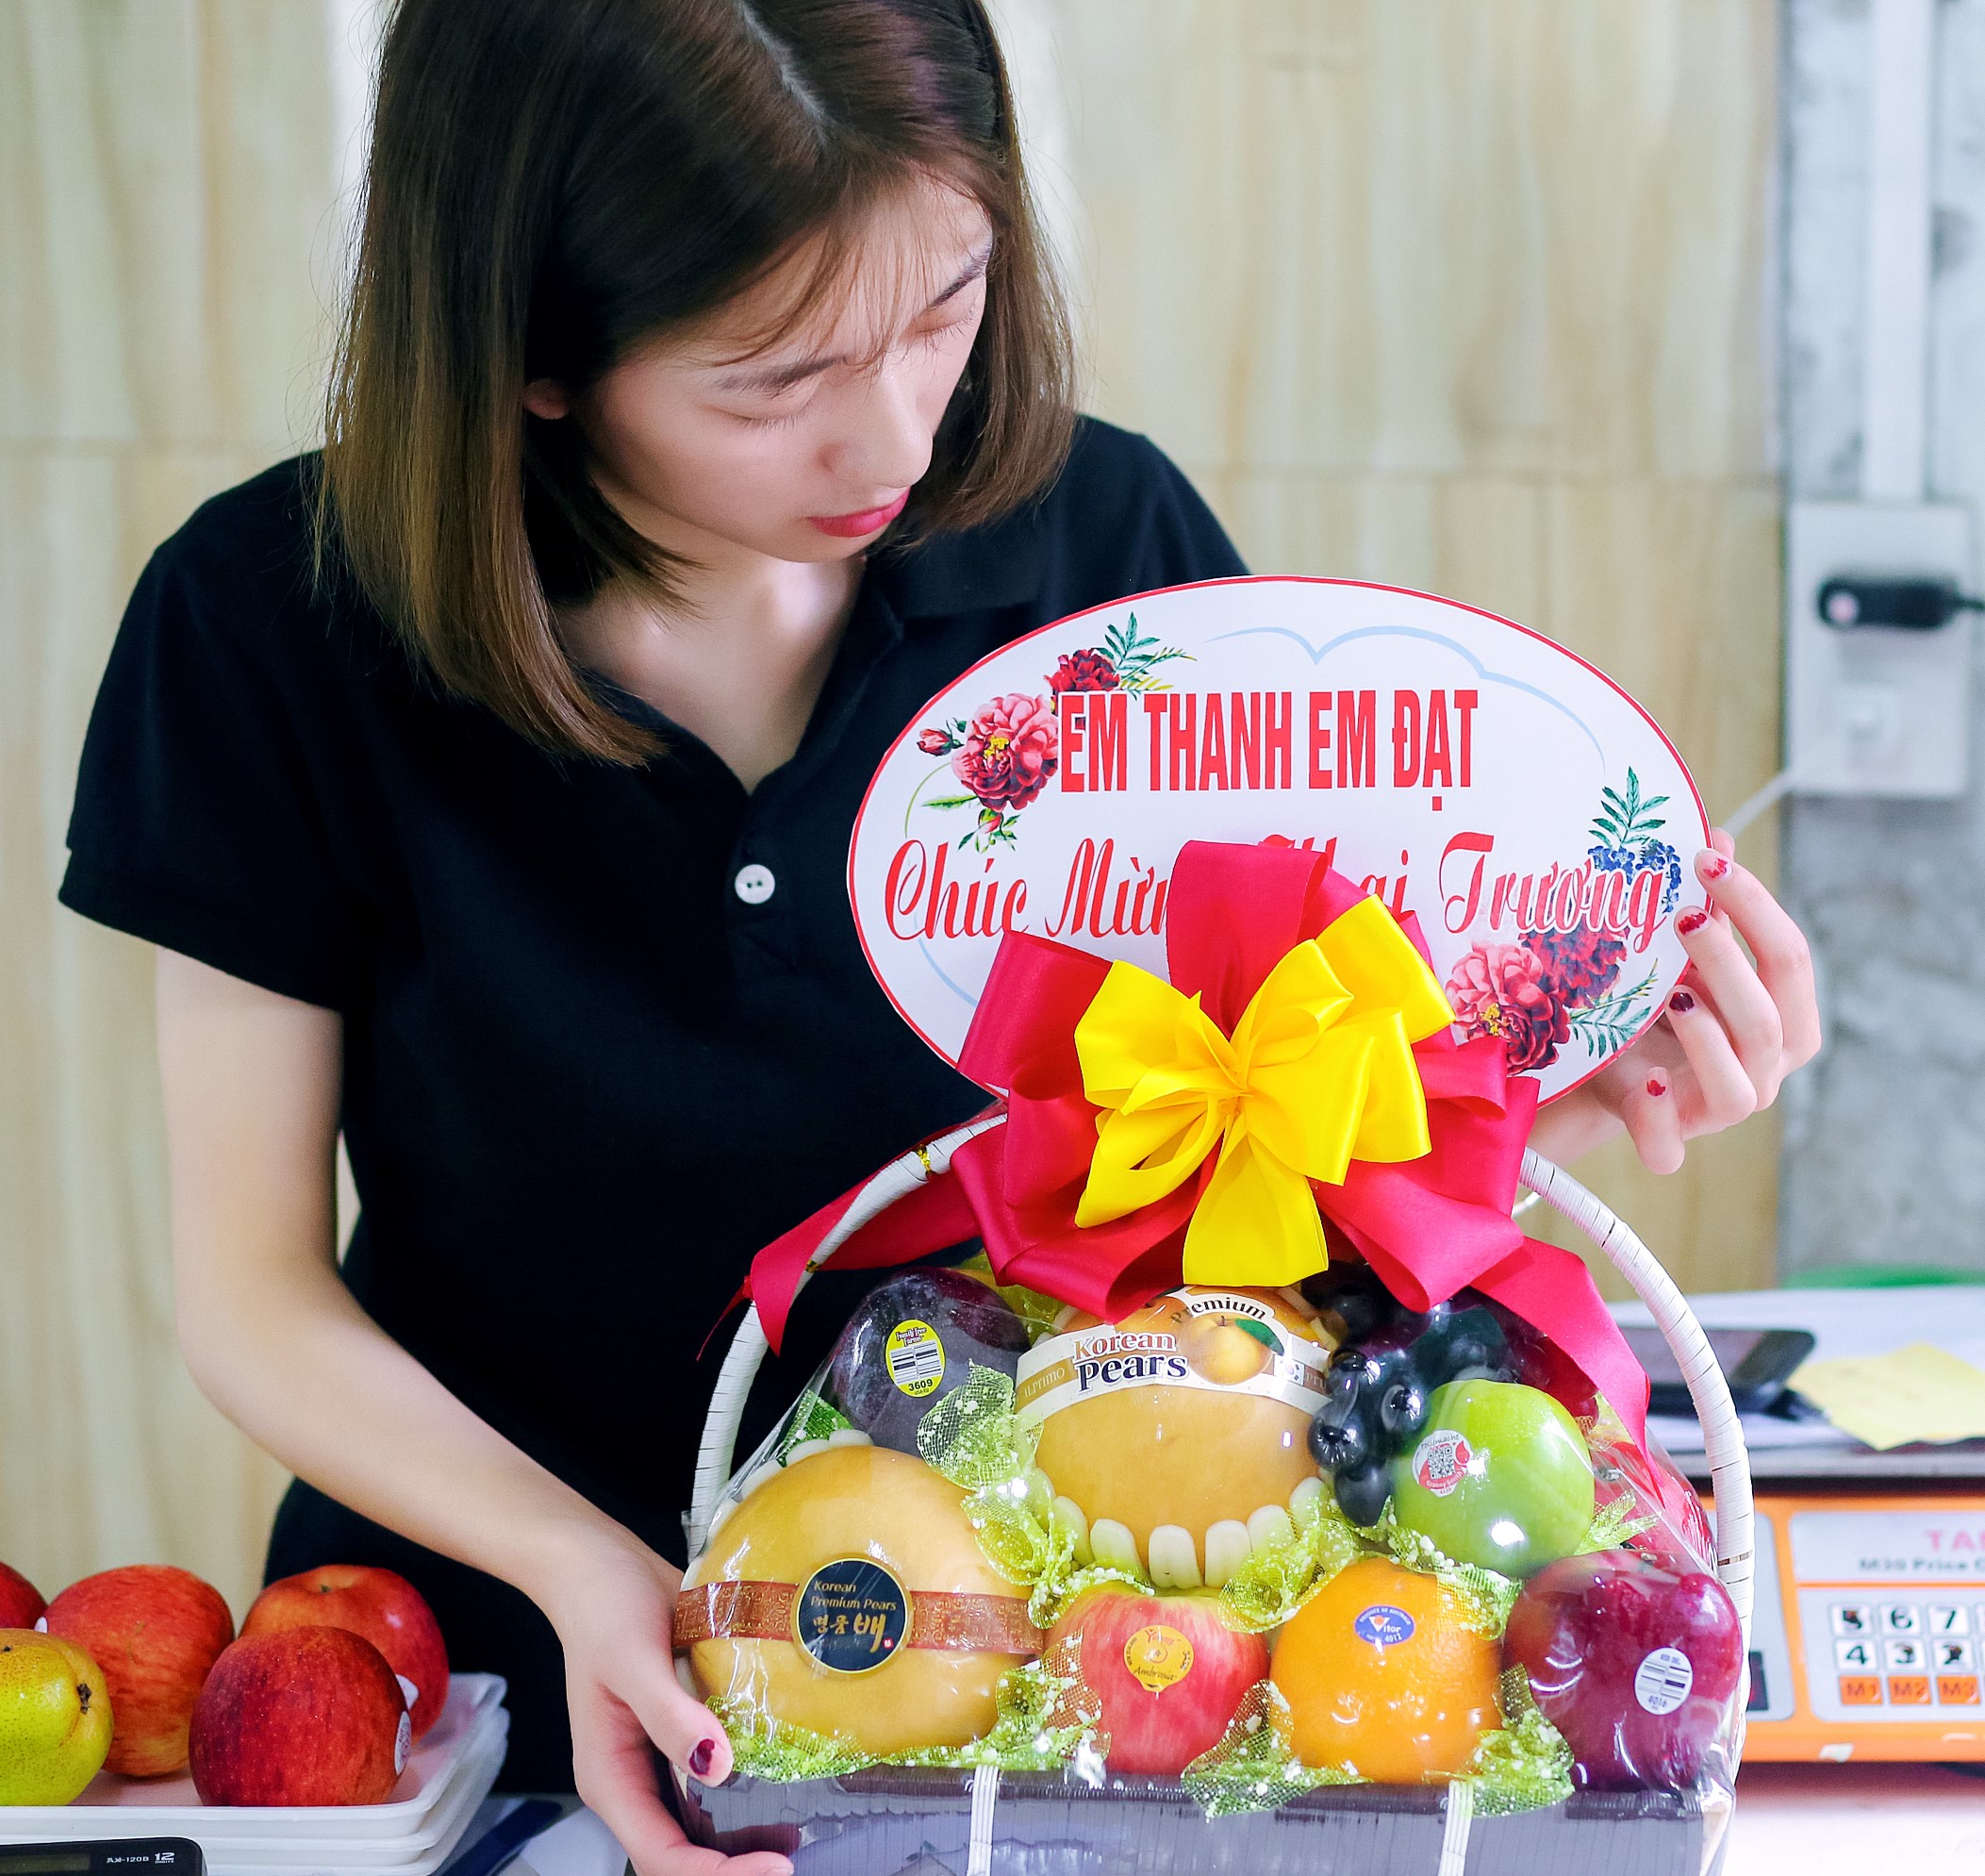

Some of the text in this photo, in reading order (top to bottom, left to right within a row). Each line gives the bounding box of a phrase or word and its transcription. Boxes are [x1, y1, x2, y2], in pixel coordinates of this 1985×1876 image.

[1061, 689, 1479, 811] EM THANH EM ĐẠT
[1439, 832, 1667, 953] Trương
[1074, 1333, 1176, 1360] Korean
[908, 1379, 934, 1391] 3609
[814, 1580, 857, 1593] Korean
[811, 1596, 897, 1611] Premium Pears
[1891, 1607, 1912, 1630] 6
[1935, 1606, 1957, 1630] 7
[1845, 1645, 1868, 1666] 4
[155, 1851, 175, 1862] 12
